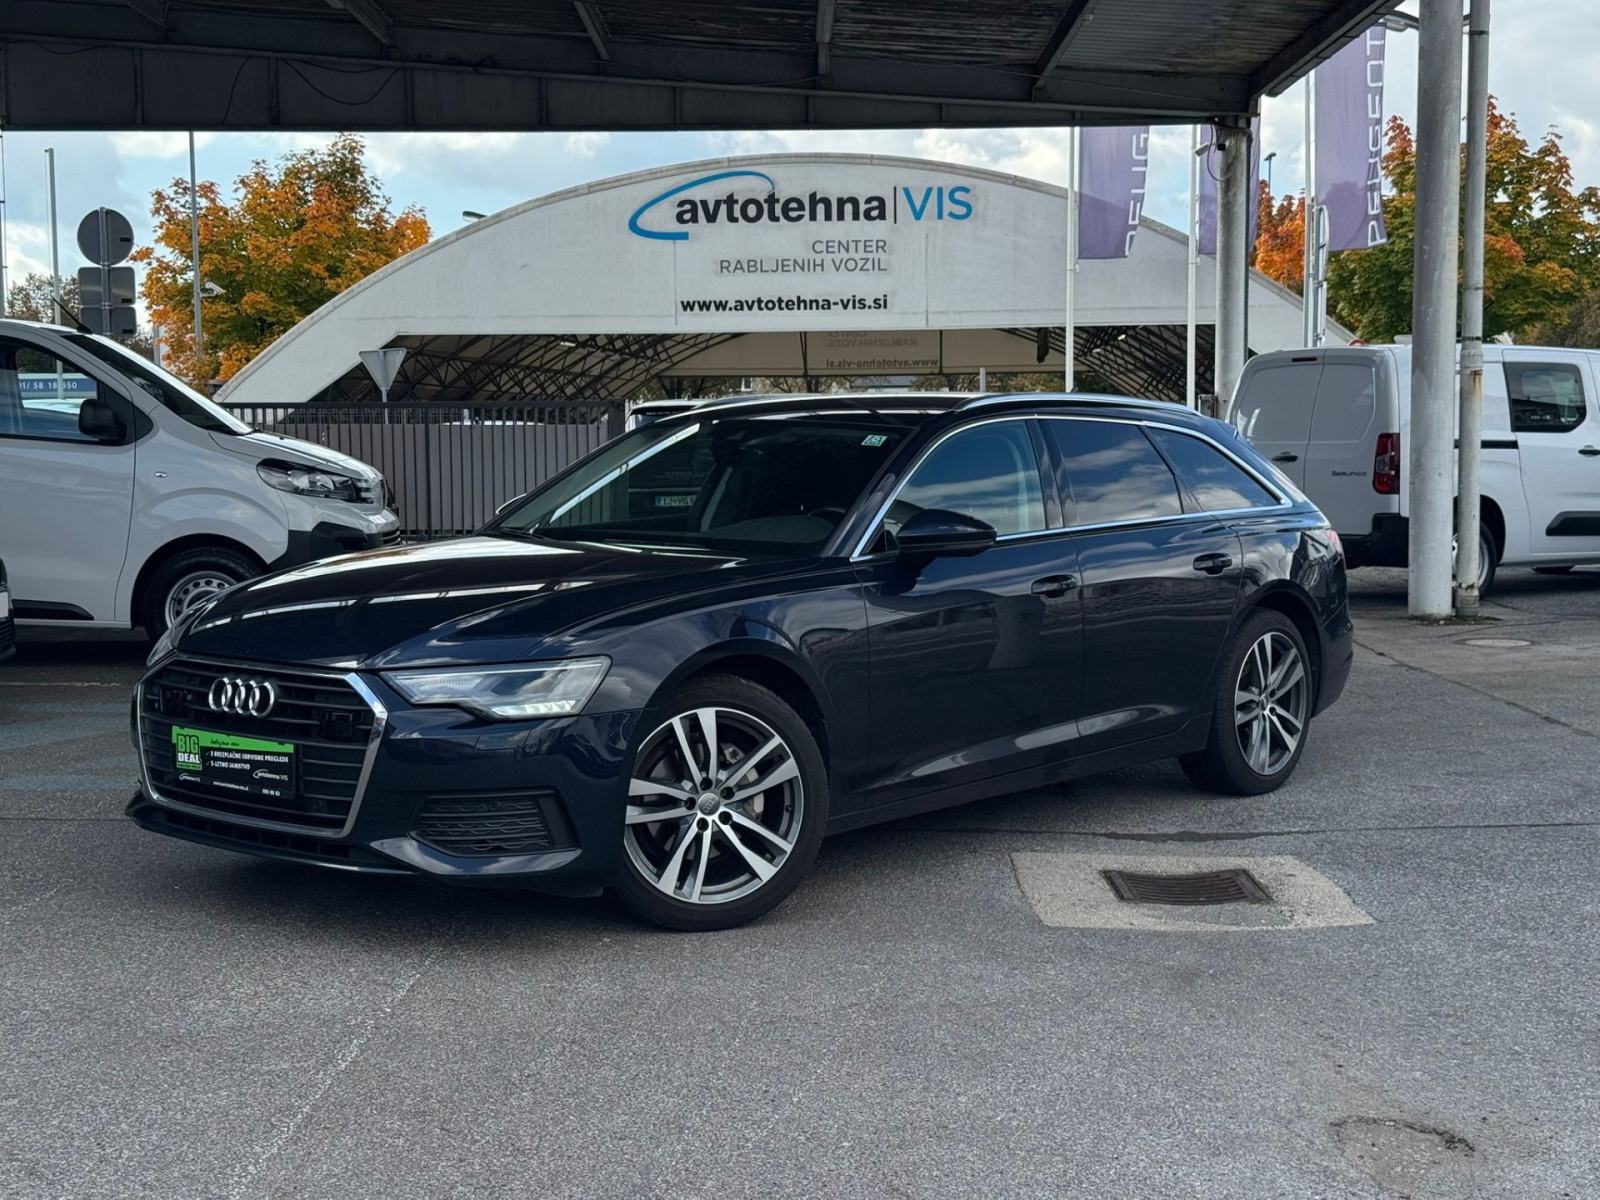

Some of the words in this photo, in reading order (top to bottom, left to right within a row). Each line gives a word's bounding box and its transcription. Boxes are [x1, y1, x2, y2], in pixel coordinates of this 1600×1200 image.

[1366, 28, 1388, 247] PEUGEOT
[675, 191, 887, 225] avtotehna
[902, 185, 974, 221] VIS
[811, 239, 887, 255] CENTER
[719, 259, 825, 275] RABLJENIH
[831, 257, 887, 273] VOZIL
[680, 294, 888, 312] www.avtotehna-vis.si
[33, 381, 44, 390] 58
[176, 734, 200, 753] BIG
[177, 752, 201, 764] DEAL
